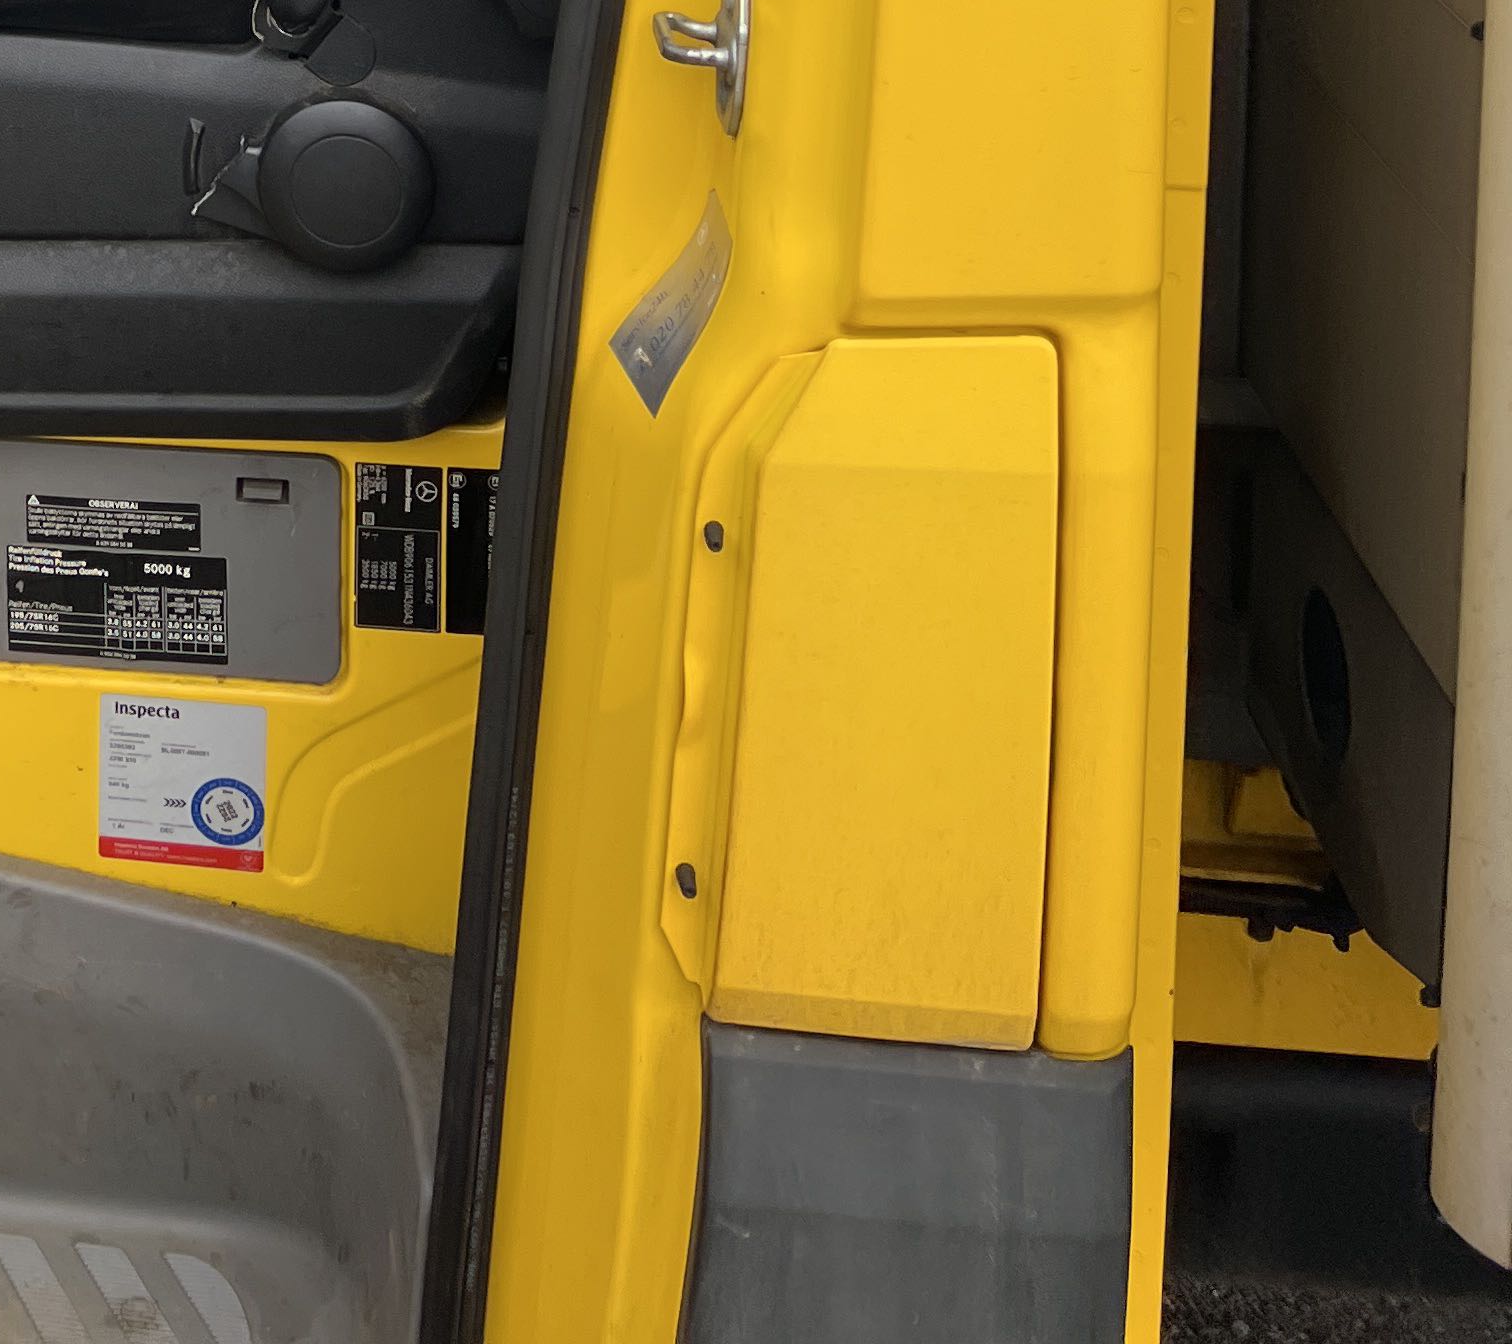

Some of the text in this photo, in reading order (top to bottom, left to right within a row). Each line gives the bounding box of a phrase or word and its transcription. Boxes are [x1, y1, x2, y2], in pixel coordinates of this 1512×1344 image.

[143, 562, 191, 579] 5000 kg
[424, 557, 434, 605] DAIMLER AG
[114, 701, 180, 720] Inspecta
